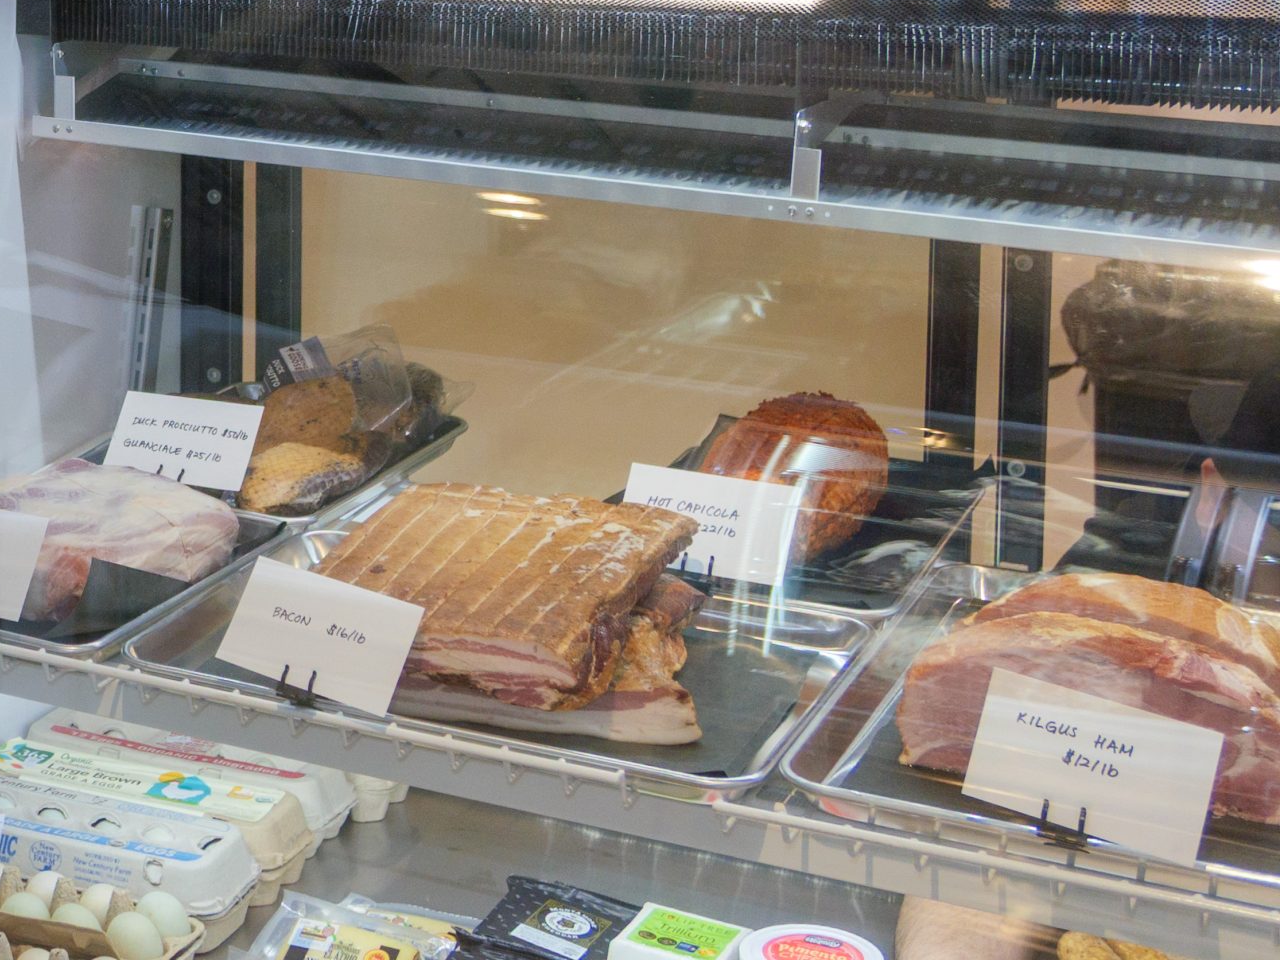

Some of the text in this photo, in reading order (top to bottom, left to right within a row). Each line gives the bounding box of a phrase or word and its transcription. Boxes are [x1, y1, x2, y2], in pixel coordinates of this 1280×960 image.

[132, 416, 158, 427] DUCK
[162, 419, 218, 436] PROSCIUTTO
[123, 438, 182, 456] GUANCIALE
[647, 495, 741, 521] HOT CAPICOLA
[697, 523, 737, 538] 22/lb
[272, 606, 367, 645] BACON $16/lb
[1016, 711, 1134, 758] KILGUS HAM
[17, 748, 49, 762] 365
[60, 753, 94, 766] Organic
[137, 745, 199, 761] ORGANIC
[212, 758, 282, 775] Ungraded
[1062, 748, 1119, 778] $12/lb
[40, 769, 72, 781] GRADE
[47, 763, 90, 776] Large
[92, 771, 142, 786] Brown
[44, 787, 77, 800] Farm
[31, 846, 60, 860] Century
[39, 841, 55, 852] New
[134, 843, 177, 857] EGGS
[73, 856, 87, 866] New
[88, 859, 114, 873] Century
[660, 923, 716, 944] Trillium
[778, 943, 848, 960] Pimento
